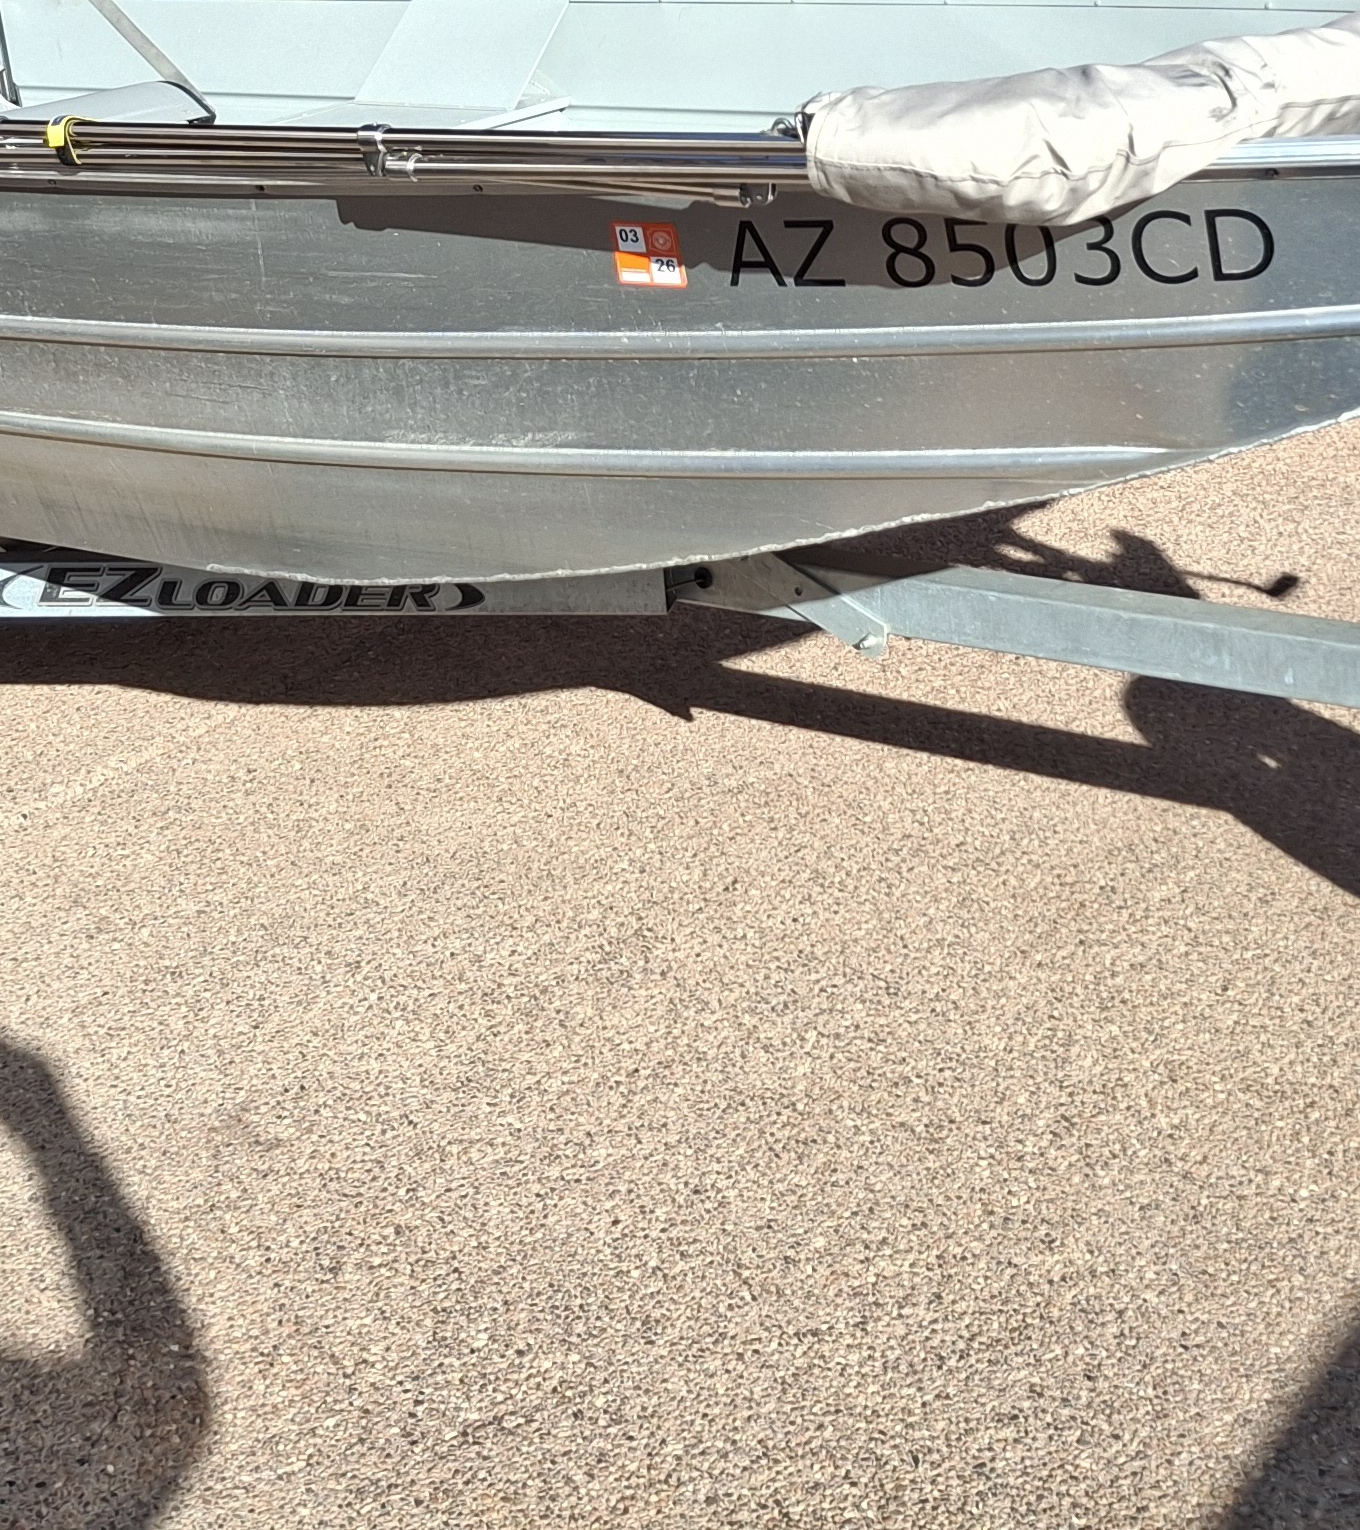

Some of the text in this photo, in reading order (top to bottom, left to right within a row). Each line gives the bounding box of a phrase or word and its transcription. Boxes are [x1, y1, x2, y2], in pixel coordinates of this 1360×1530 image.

[619, 228, 639, 243] 03
[729, 208, 1275, 288] AZ 8503CD
[655, 258, 676, 273] 26
